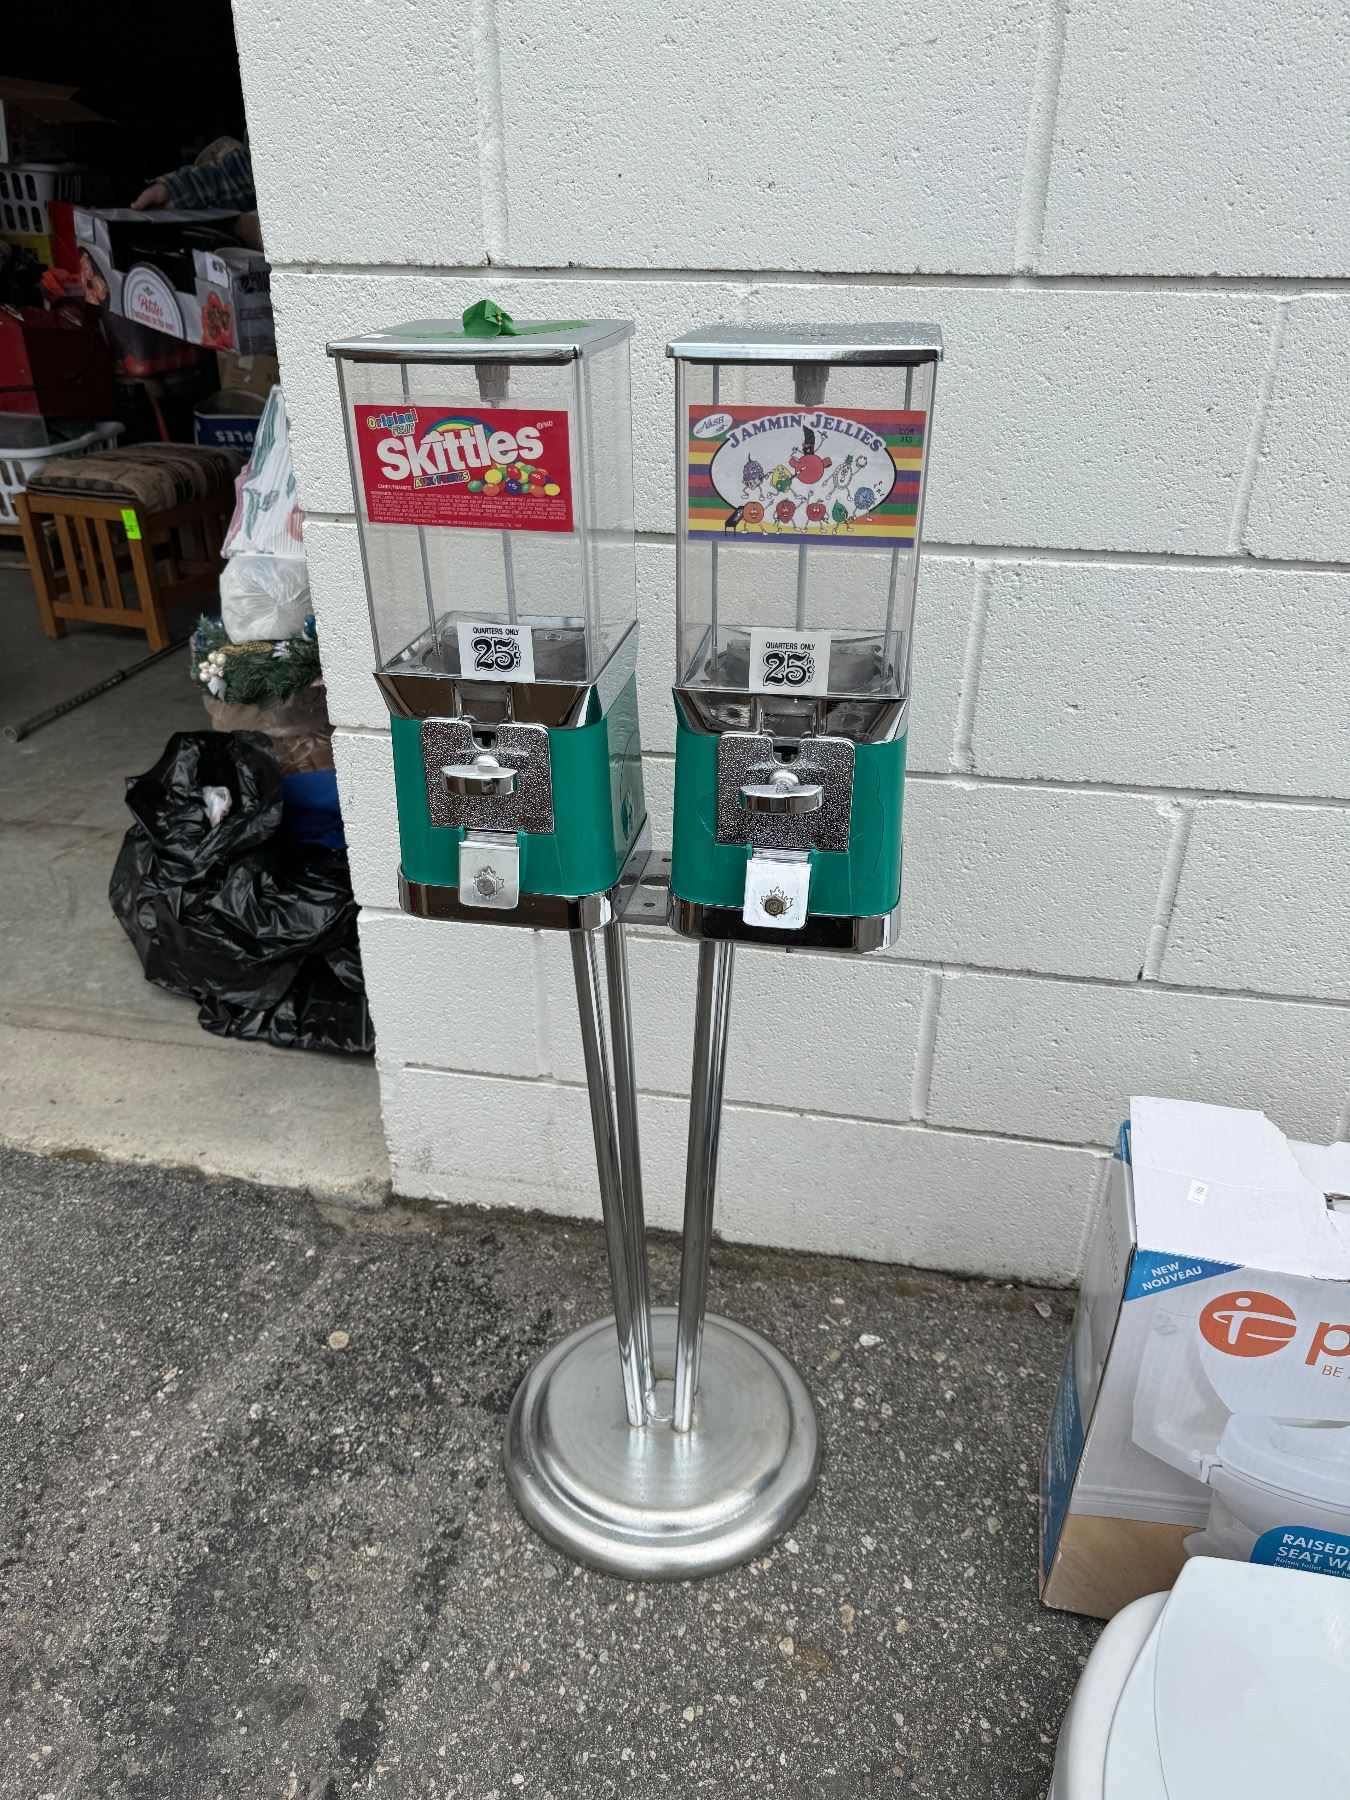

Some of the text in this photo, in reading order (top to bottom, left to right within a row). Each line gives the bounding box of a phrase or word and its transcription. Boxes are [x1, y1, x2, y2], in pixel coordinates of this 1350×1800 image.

[367, 408, 418, 429] Original
[729, 413, 883, 452] JAMMIN' JELLIES
[472, 627, 520, 636] QUARTERS ONLY
[765, 641, 816, 651] QUARTERS ONLY
[1141, 1265, 1203, 1291] NOUVEAU
[1150, 1261, 1180, 1277] NEW
[1321, 1364, 1344, 1378] BE
[1282, 1533, 1350, 1556] RAISED
[1277, 1546, 1324, 1564] SEAT
